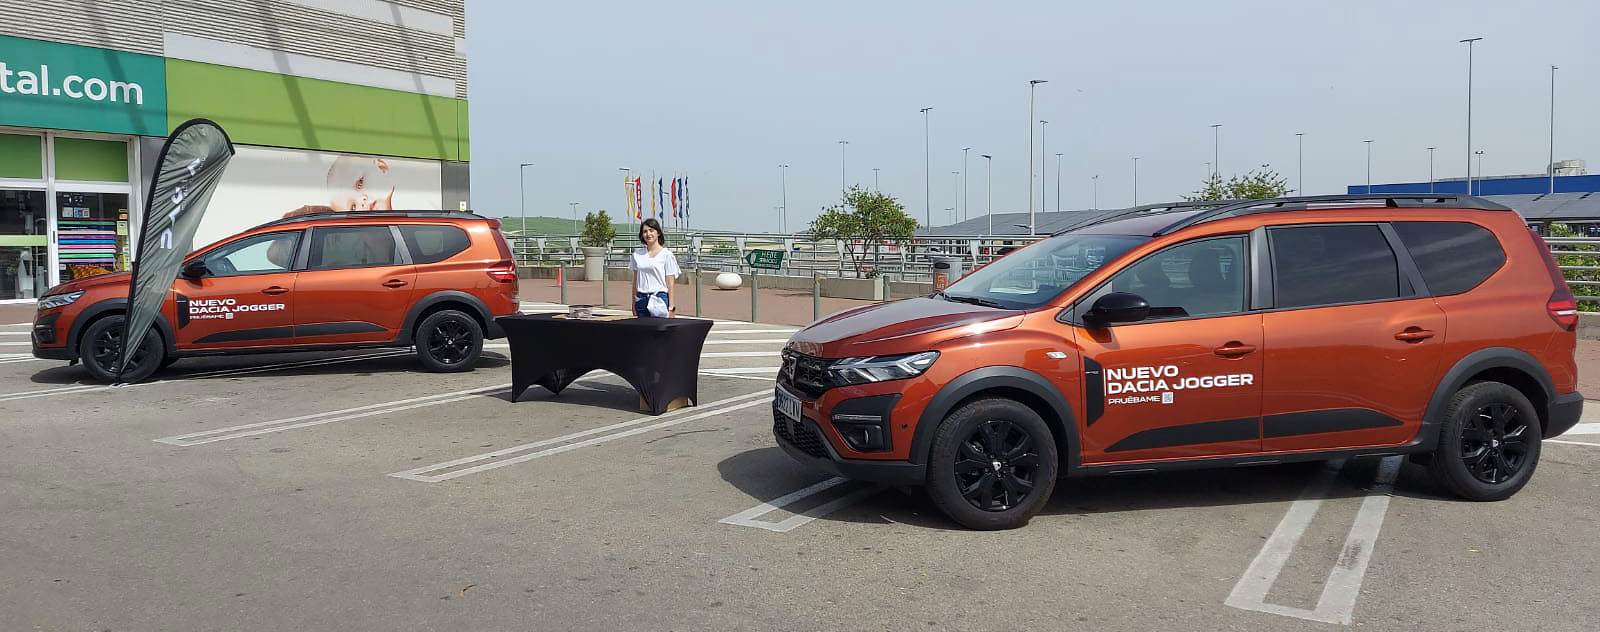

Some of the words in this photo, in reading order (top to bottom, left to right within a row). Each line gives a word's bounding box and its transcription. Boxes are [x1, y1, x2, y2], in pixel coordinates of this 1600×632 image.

[189, 299, 236, 307] NUEVO
[189, 306, 230, 314] DACIA
[232, 304, 285, 312] JOGGER
[1107, 365, 1179, 381] NUEVO
[1107, 379, 1170, 395] DACIA
[1173, 374, 1254, 390] JOGGER
